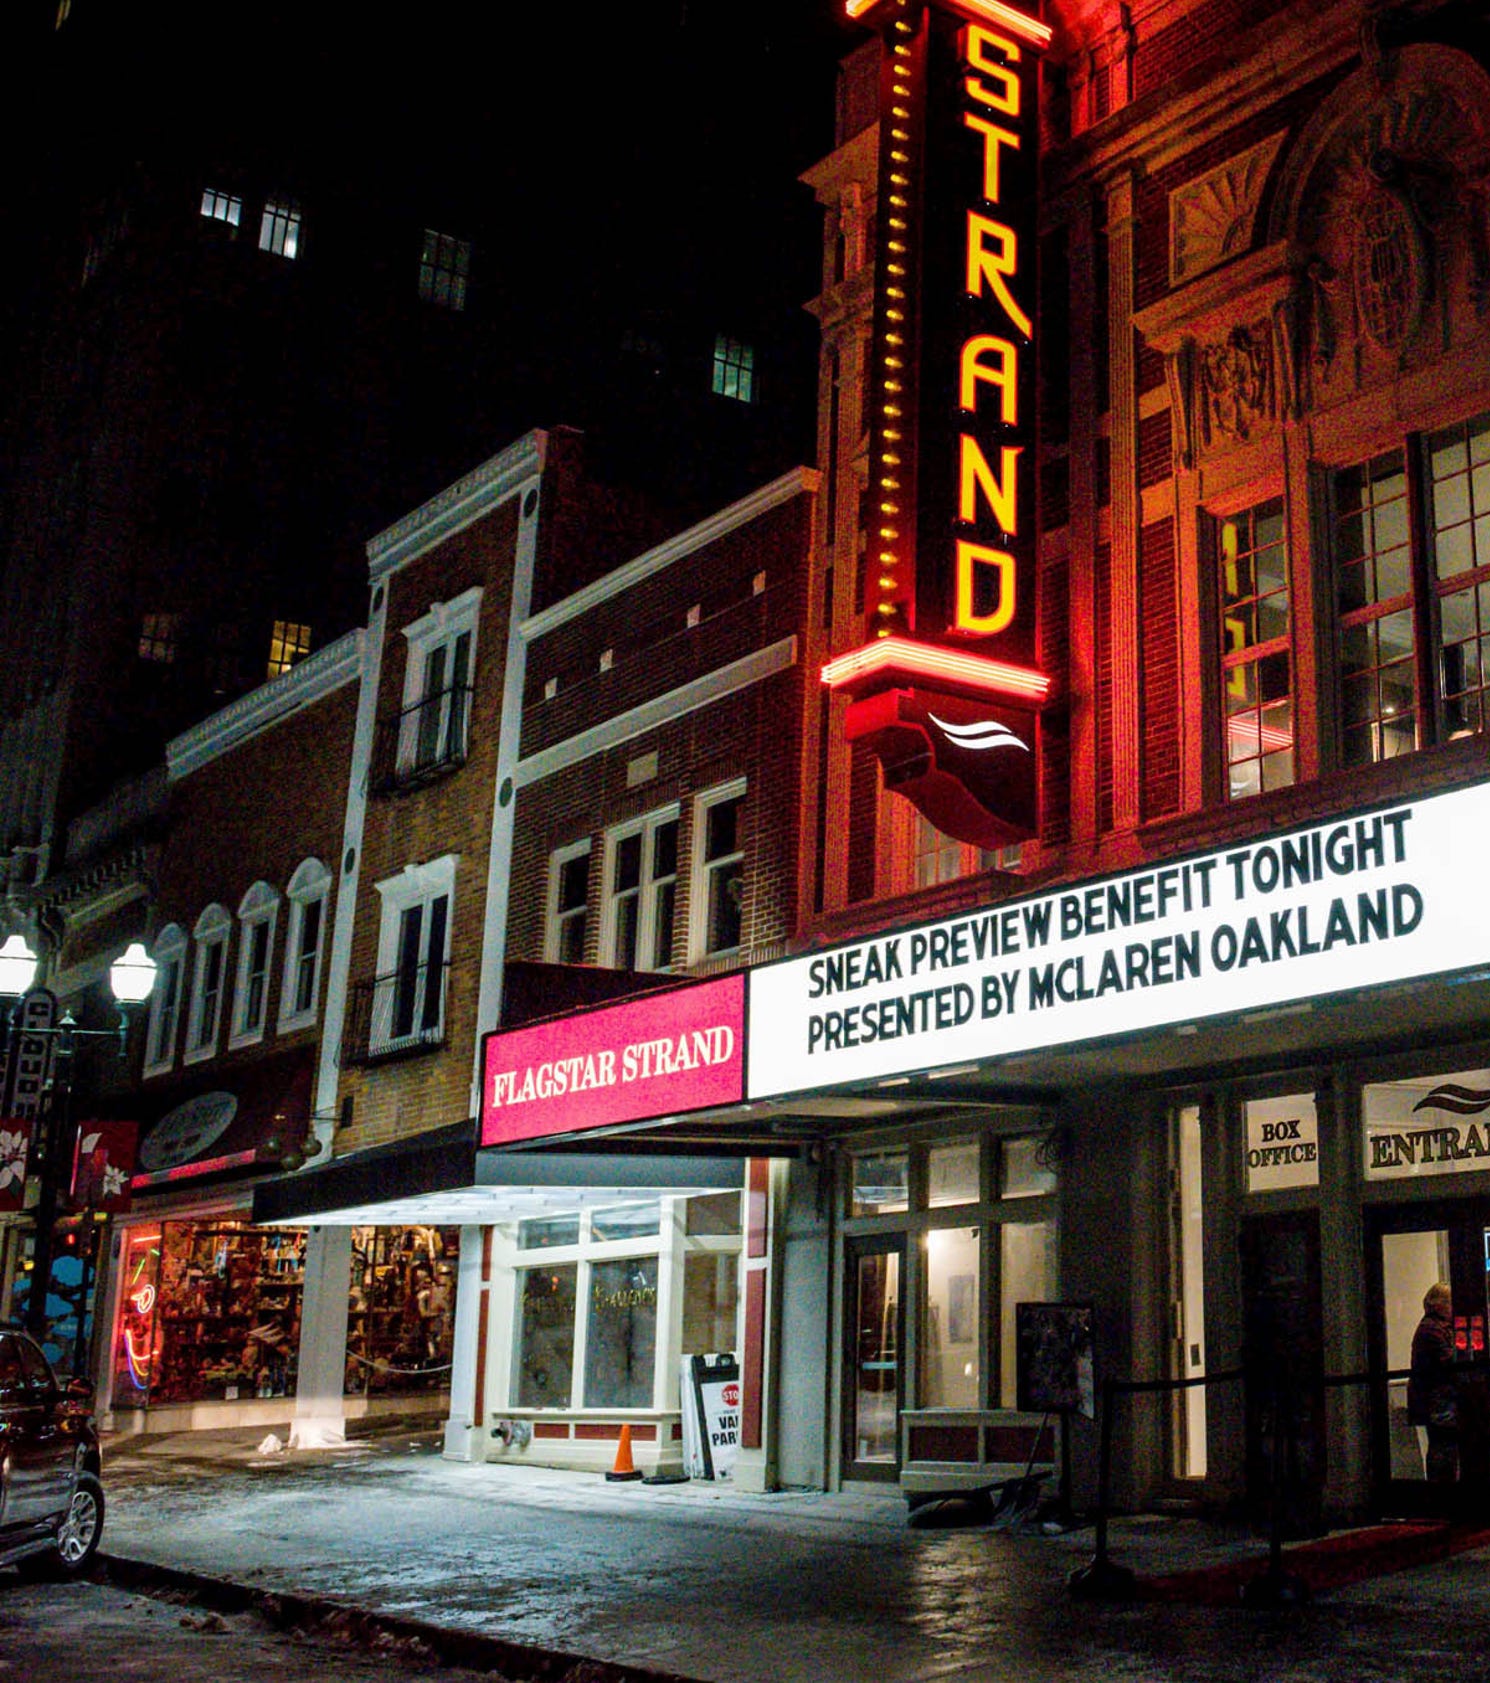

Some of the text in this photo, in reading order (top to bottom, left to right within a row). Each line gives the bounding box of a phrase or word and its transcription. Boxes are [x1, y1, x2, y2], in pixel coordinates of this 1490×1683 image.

[956, 24, 1032, 635] STRAND
[809, 808, 1412, 998] SNEAK PREVIEW BENEFIT TONIGHT
[808, 884, 1423, 1054] PRESENTED BY MCLAREN OAKLAND
[492, 1025, 734, 1108] FLAGSTAR STRAND
[1248, 1142, 1317, 1168] OFFICE
[1261, 1120, 1301, 1142] BOX
[711, 1431, 739, 1446] PAR
